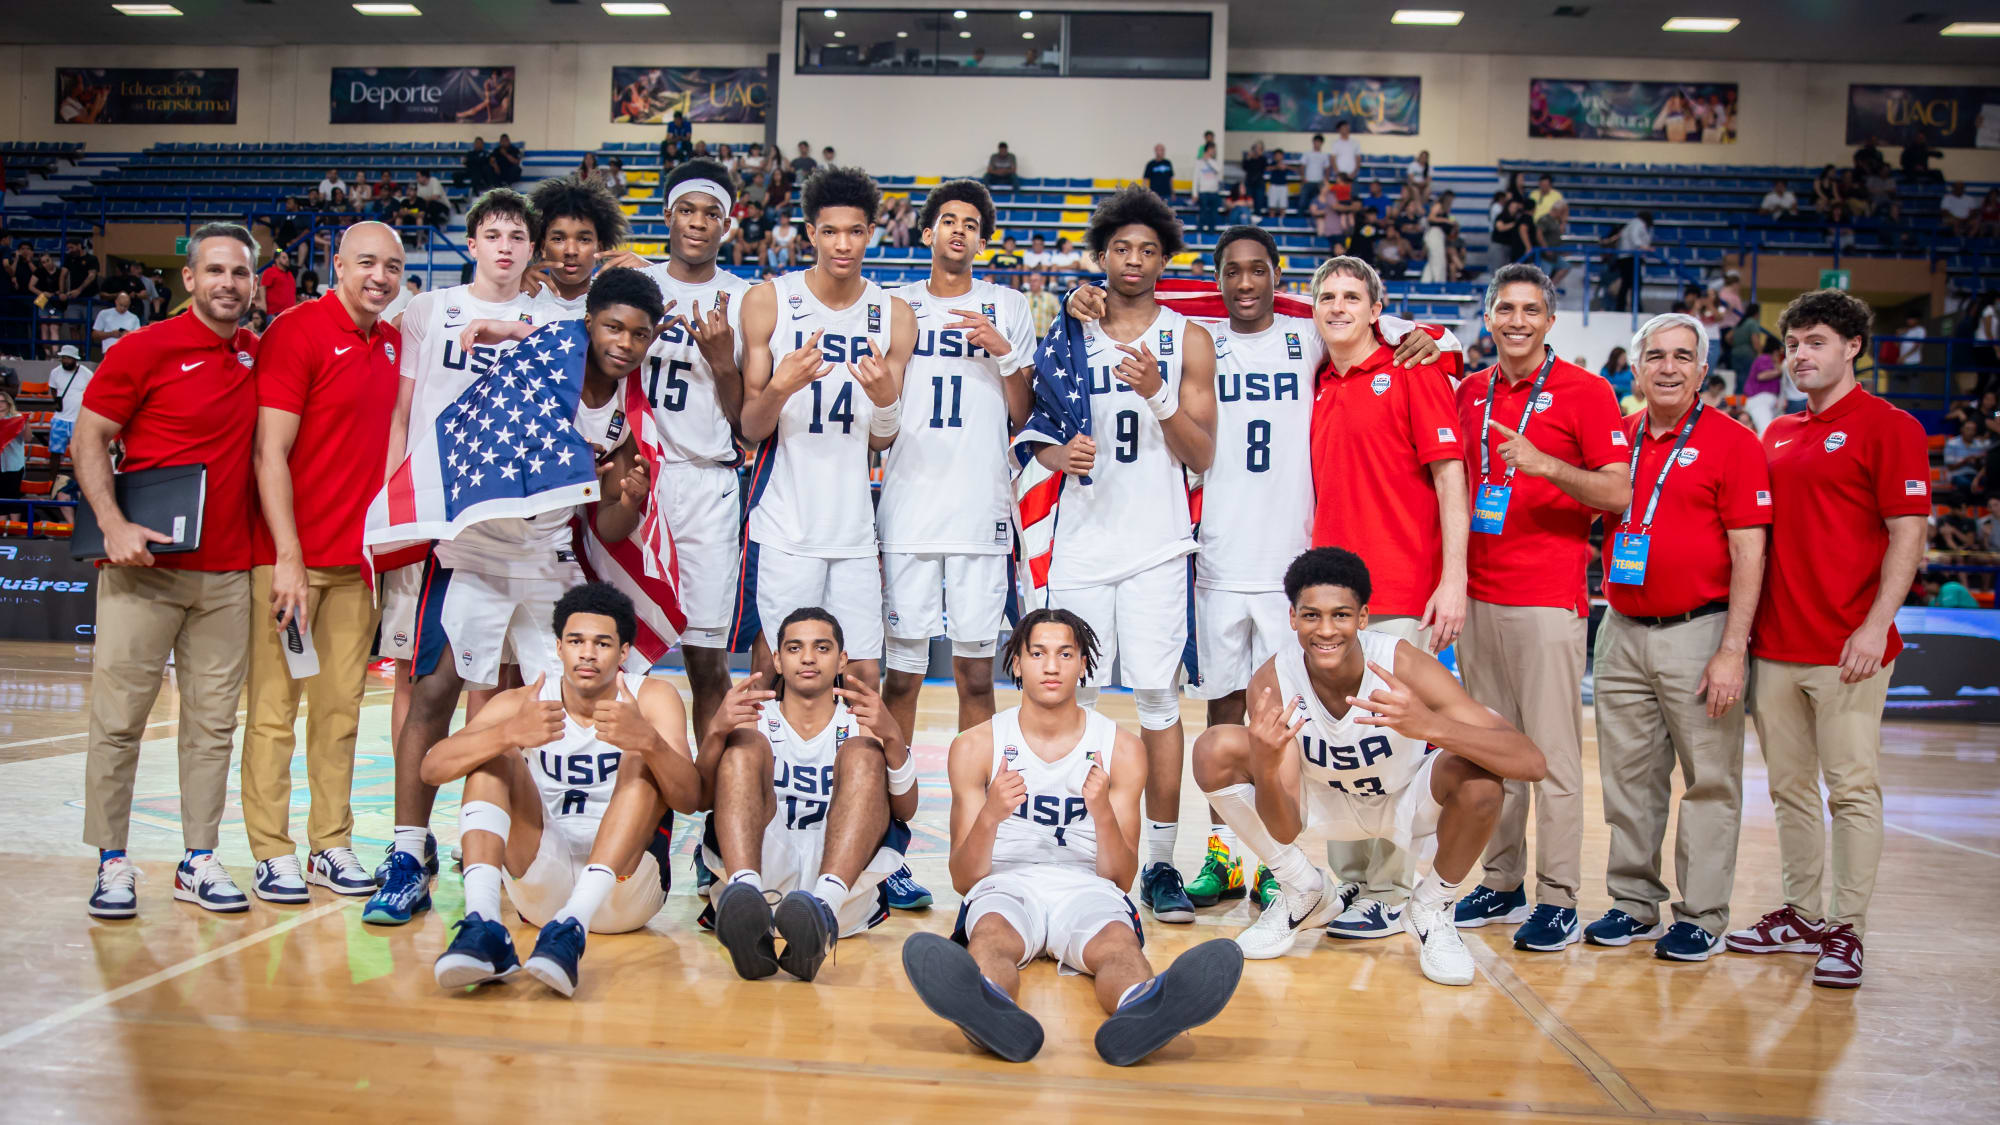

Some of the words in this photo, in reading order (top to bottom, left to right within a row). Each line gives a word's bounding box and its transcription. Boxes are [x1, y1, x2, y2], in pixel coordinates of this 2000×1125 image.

[120, 80, 201, 97] Educación
[145, 98, 230, 112] transforma
[350, 81, 442, 111] Deporte
[710, 82, 768, 115] UAC
[1317, 90, 1385, 124] UACJ
[1887, 99, 1958, 136] UACJ
[443, 339, 509, 375] US
[648, 356, 692, 412] 15
[929, 375, 962, 428] 11
[1218, 372, 1298, 402] USA
[809, 380, 854, 434] 14
[1115, 409, 1138, 463] 9
[1246, 419, 1271, 473] 8
[540, 749, 622, 785] USA
[1302, 734, 1392, 770] USA
